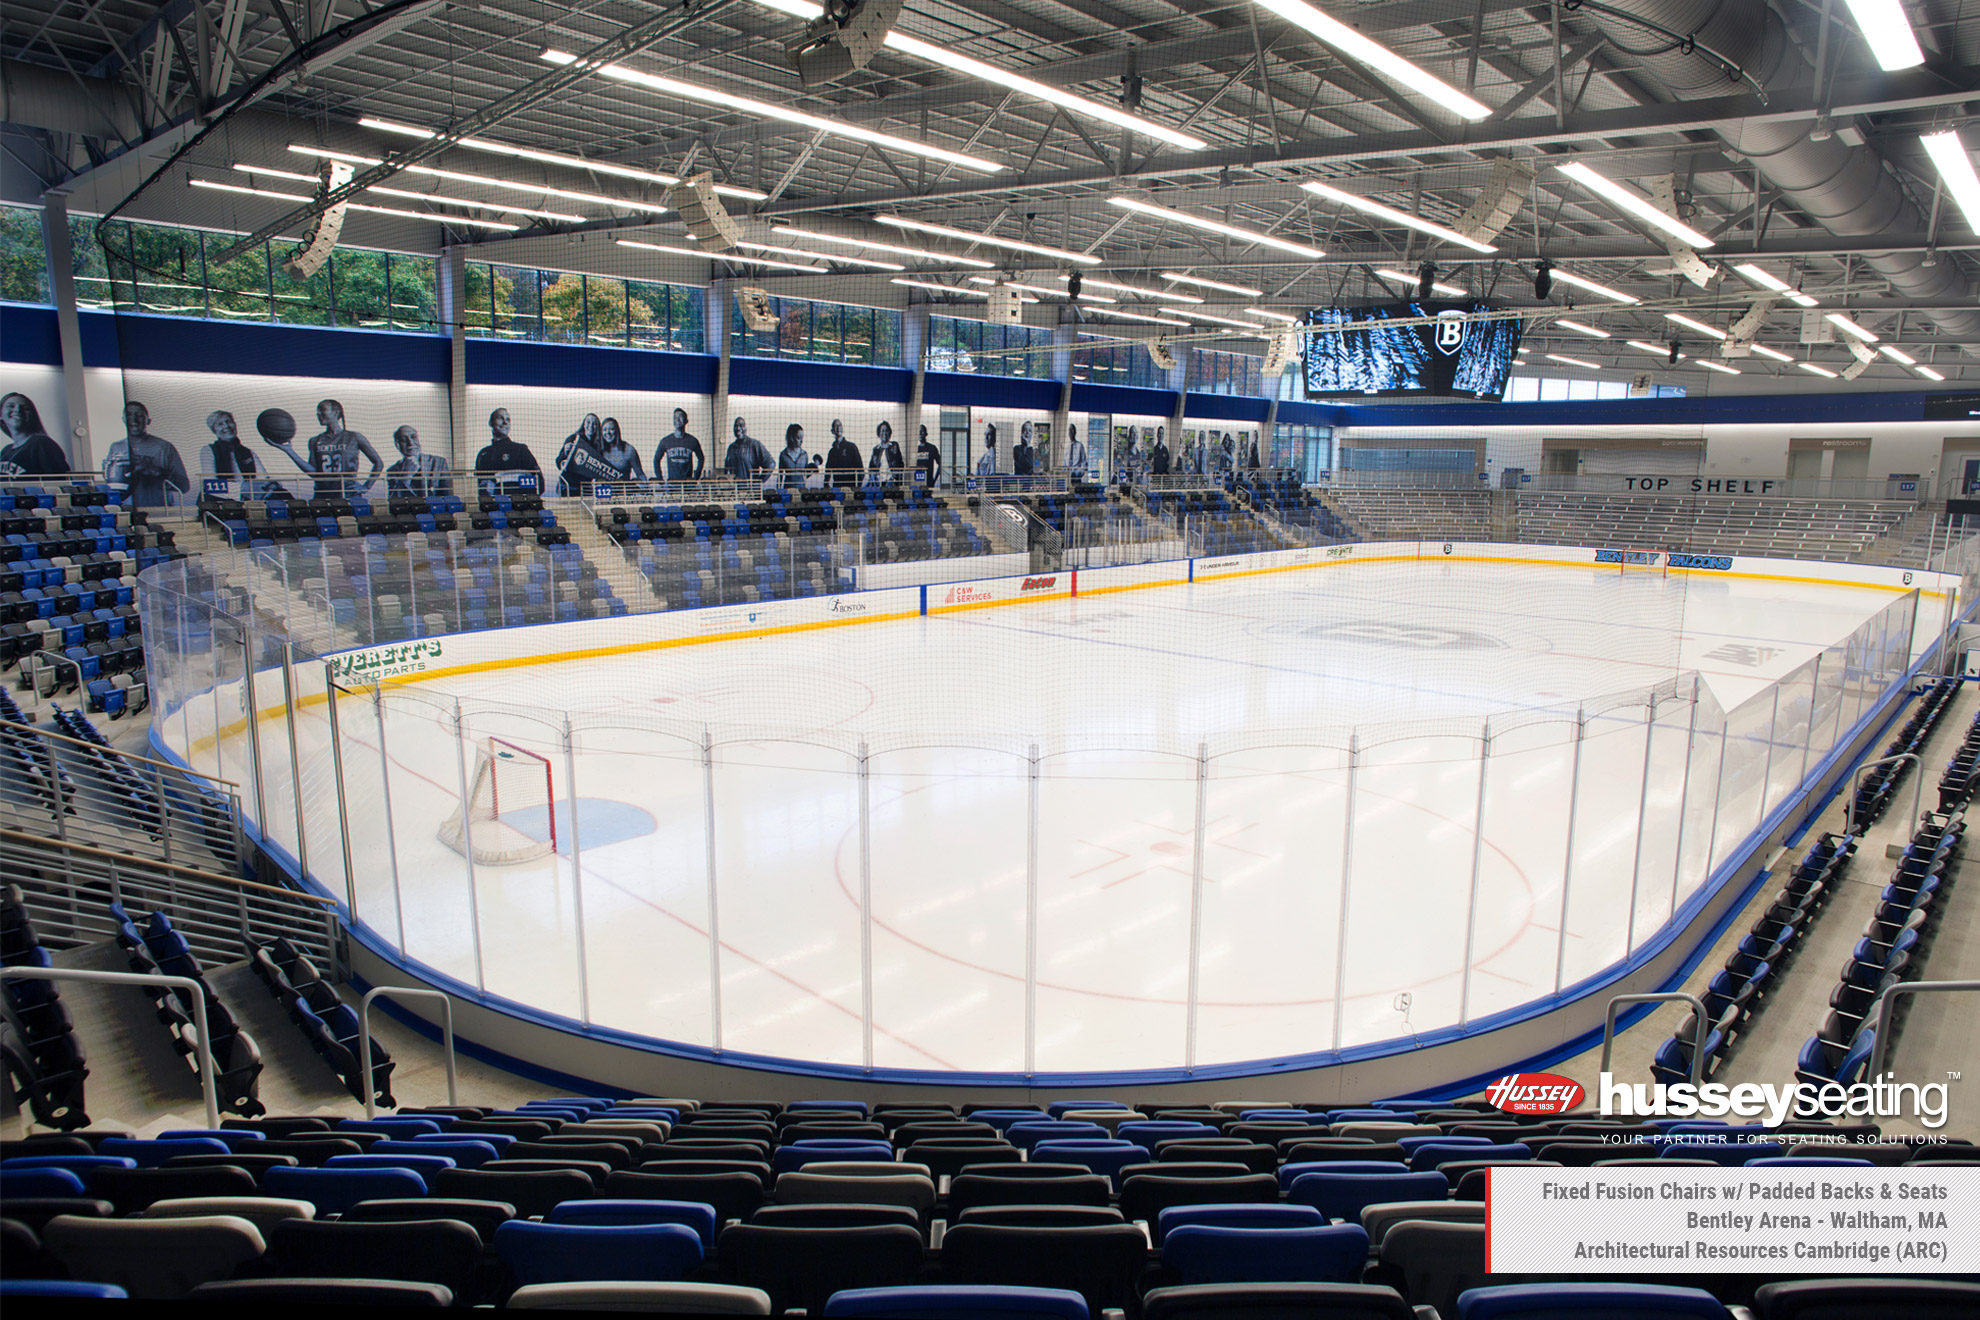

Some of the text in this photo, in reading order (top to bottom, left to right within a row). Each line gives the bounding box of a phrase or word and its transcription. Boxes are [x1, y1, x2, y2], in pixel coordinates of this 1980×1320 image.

[1441, 320, 1463, 345] B
[322, 454, 342, 472] 23
[586, 455, 624, 480] BENTLEY
[206, 482, 227, 491] 111
[520, 478, 536, 486] 111
[1625, 478, 1774, 493] TOP SHELF
[597, 488, 611, 496] 112
[1595, 550, 1733, 570] BENTLEY FALCONS
[956, 587, 973, 595] C&W
[1020, 577, 1056, 591] Eaton
[957, 592, 992, 603] SERVICES
[839, 604, 866, 613] BOSTON
[344, 662, 426, 686] AUTO PARTS
